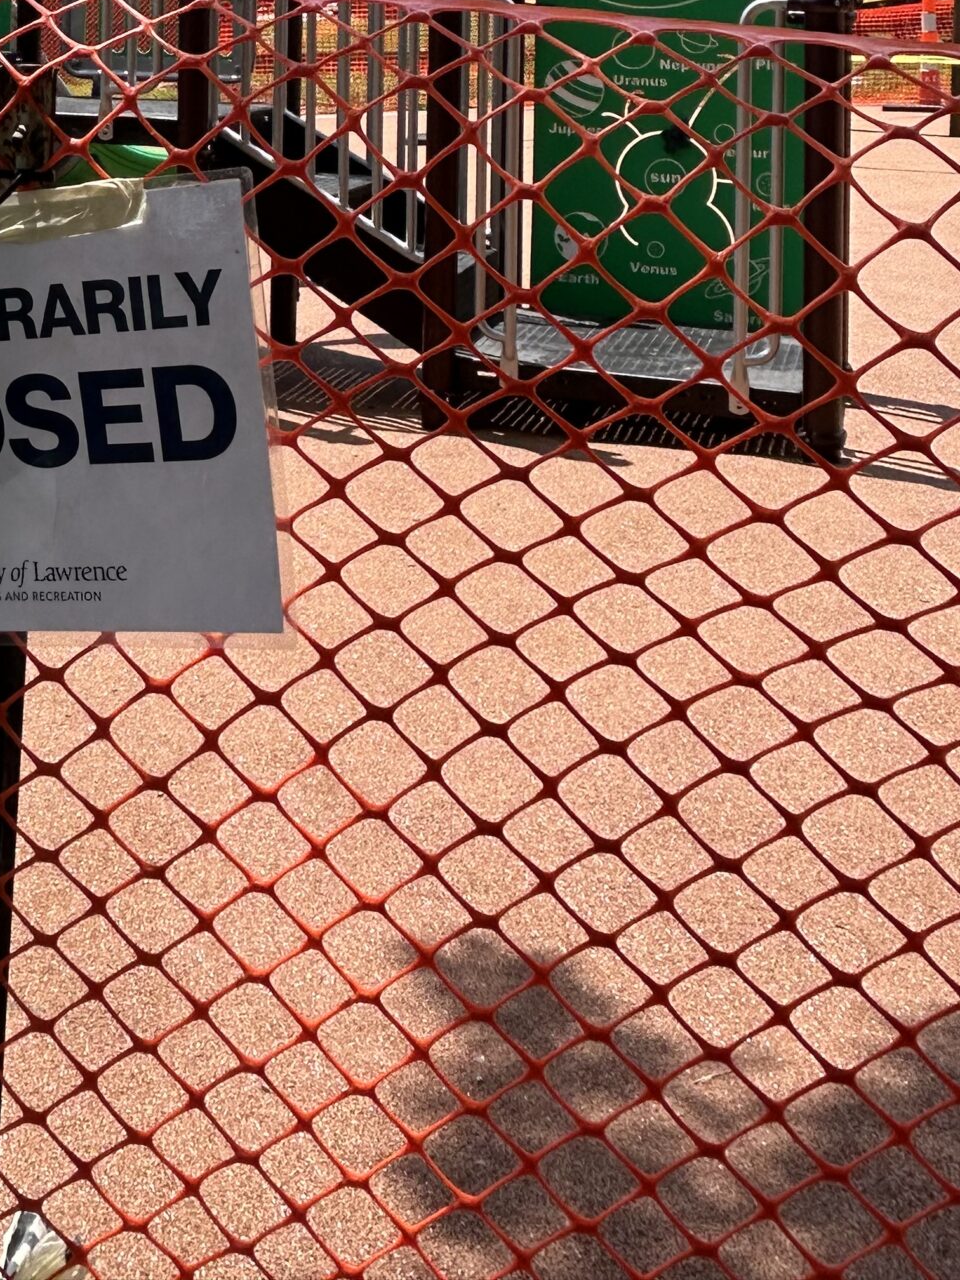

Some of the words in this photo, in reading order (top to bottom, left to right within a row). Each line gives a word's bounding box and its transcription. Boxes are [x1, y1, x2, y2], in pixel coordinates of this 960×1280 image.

[613, 74, 668, 87] Uranus
[630, 262, 678, 276] Venus
[557, 273, 600, 285] Earth
[10, 560, 29, 588] of
[33, 561, 128, 582] Lawrence
[4, 591, 29, 602] AND
[32, 591, 102, 602] RECREATION
